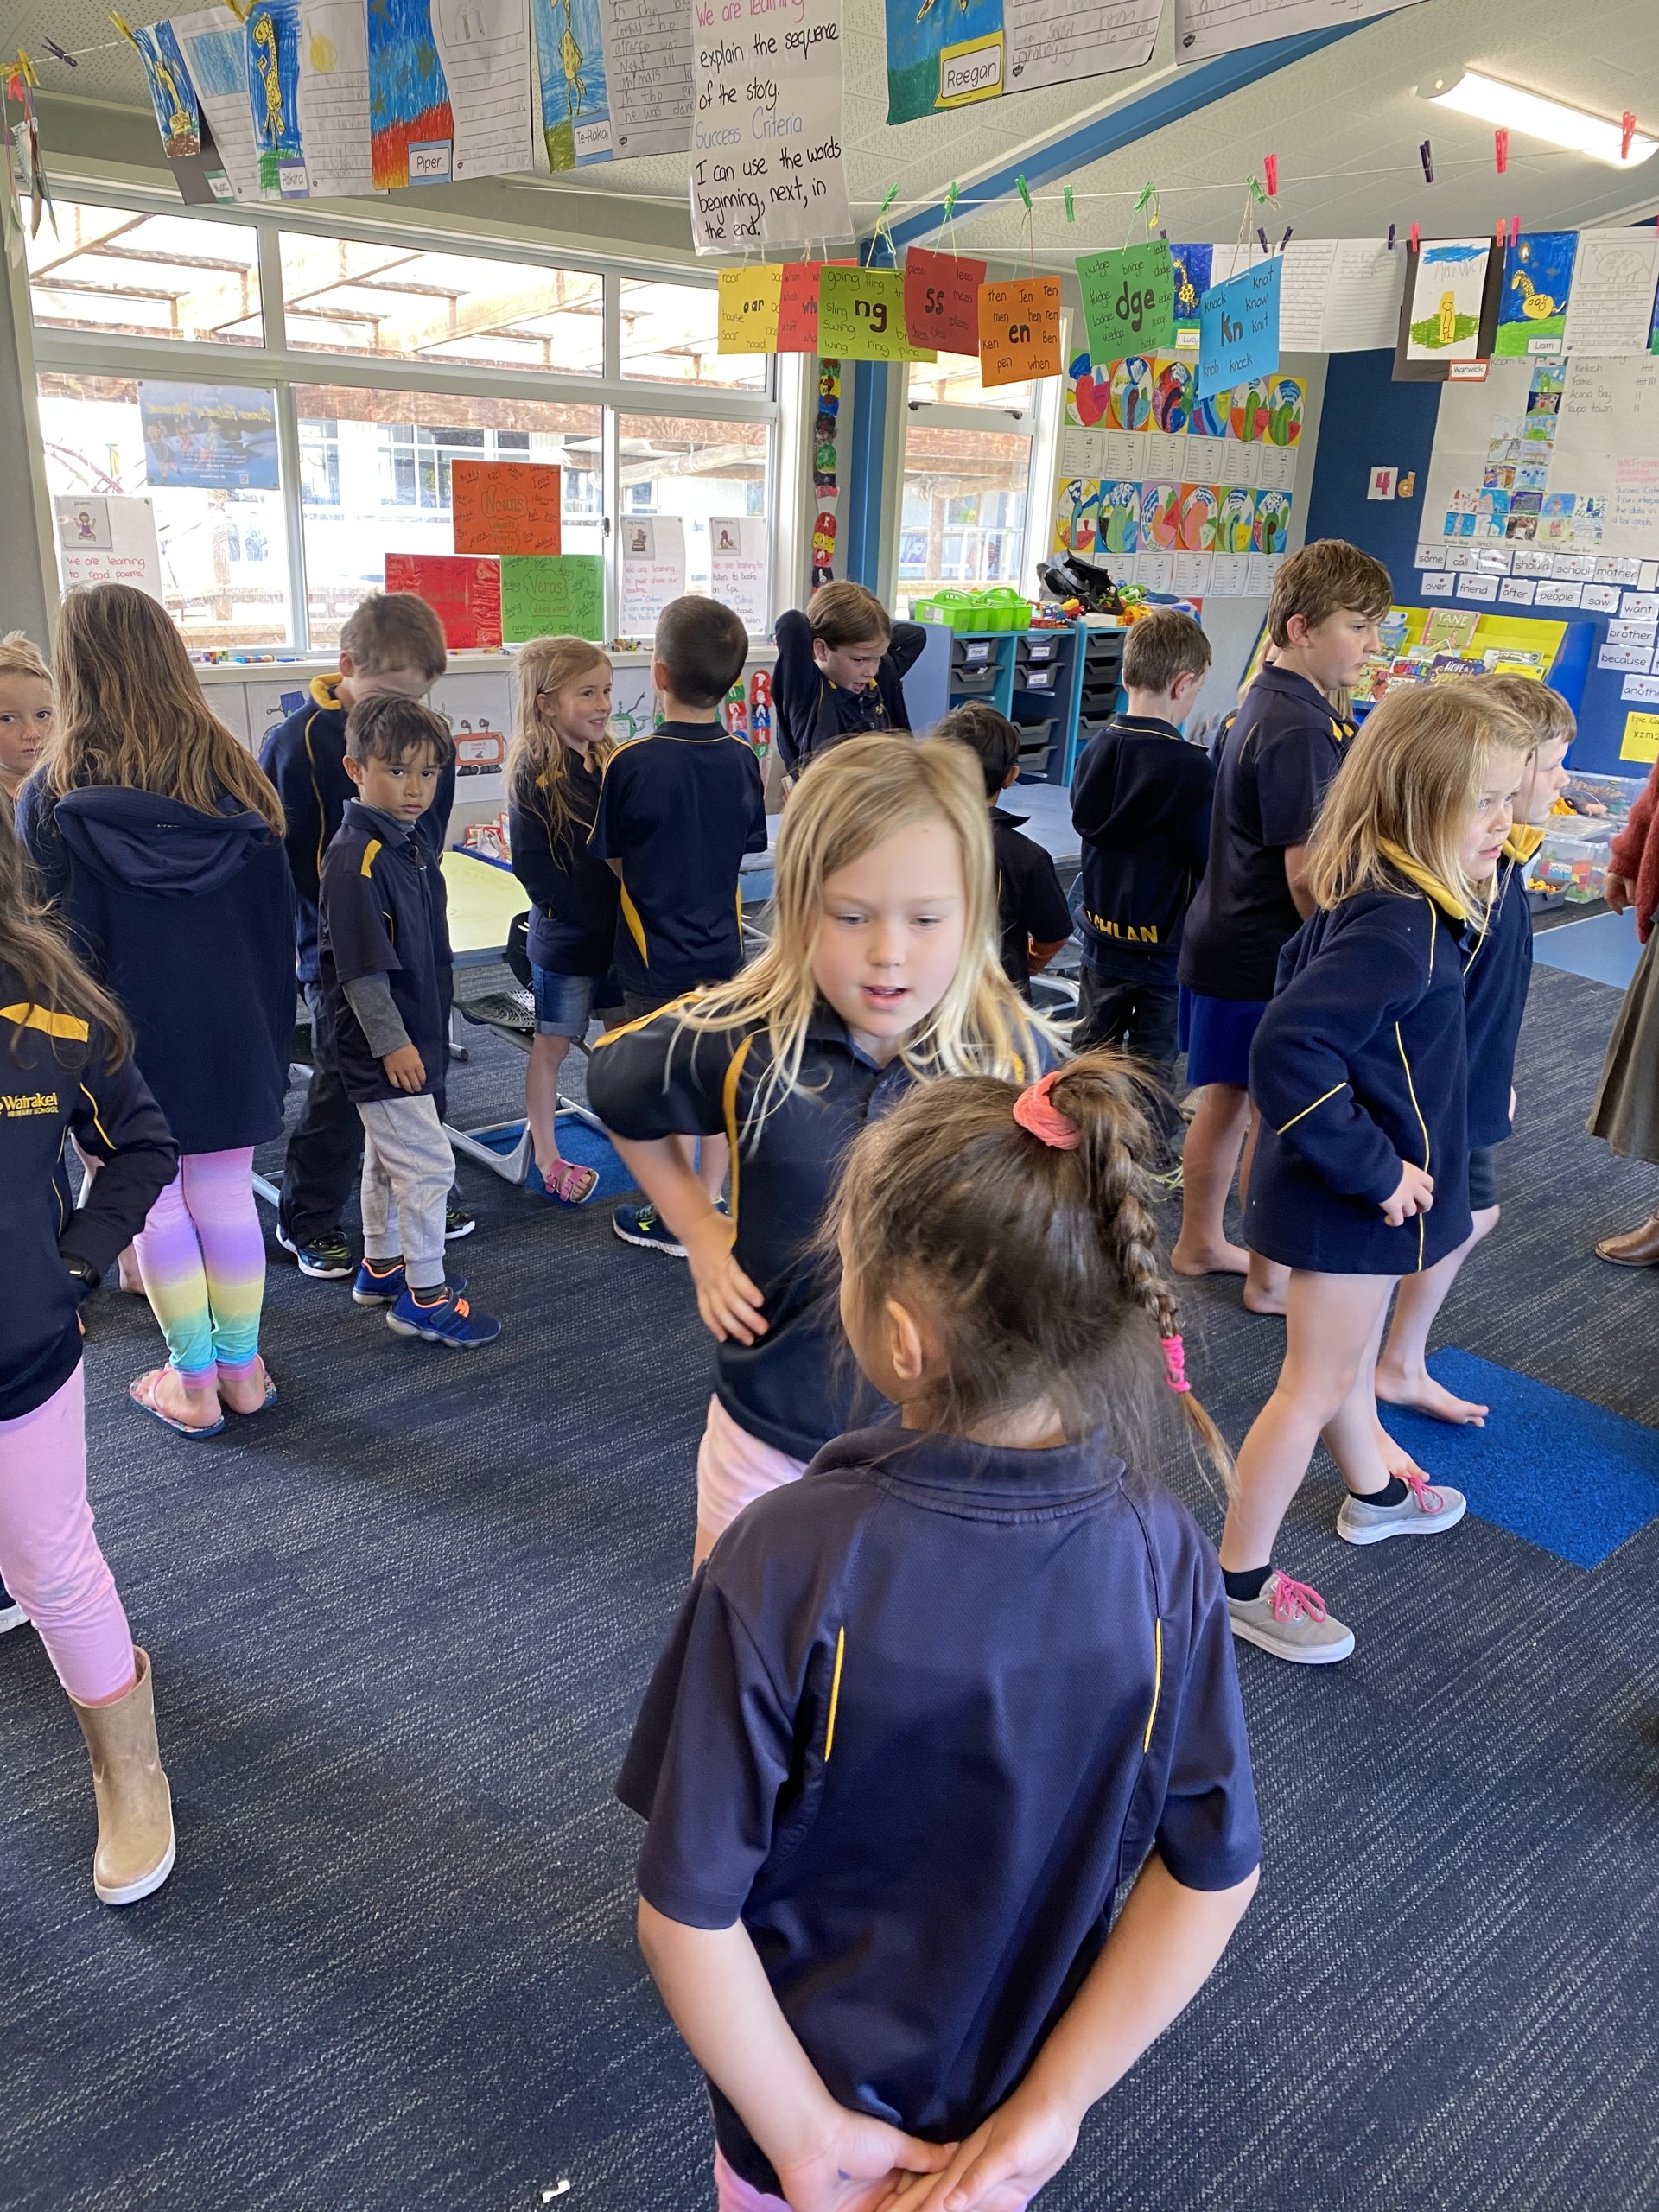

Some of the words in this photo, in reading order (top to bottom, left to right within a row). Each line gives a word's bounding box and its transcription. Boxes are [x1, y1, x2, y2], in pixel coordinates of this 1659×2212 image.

[696, 2, 714, 27] We
[722, 2, 741, 21] are
[700, 40, 744, 74] explain
[753, 33, 778, 55] the
[785, 23, 839, 60] sequence
[947, 61, 997, 88] Reegan
[699, 80, 714, 110] of
[719, 83, 737, 105] the
[747, 77, 780, 111] story.
[625, 109, 636, 124] he
[643, 105, 661, 120] was
[696, 120, 741, 149] Success
[752, 105, 803, 140] Criteria
[416, 156, 442, 174] Piper
[695, 159, 708, 186] I
[713, 165, 734, 182] can
[742, 157, 768, 176] use
[779, 147, 804, 169] the
[807, 135, 842, 163] words
[697, 188, 766, 226] beginning,
[769, 175, 809, 209] next,
[812, 178, 826, 197] in
[705, 221, 727, 239] the
[733, 216, 761, 237] end.
[721, 272, 741, 283] roar
[957, 267, 973, 282] less
[1085, 260, 1110, 278] judge
[1122, 260, 1144, 277] bridge
[827, 271, 861, 291] going
[865, 273, 885, 295] fling
[953, 290, 973, 304] mess
[988, 289, 1007, 302] then
[1018, 289, 1033, 303] Jen
[1044, 282, 1058, 296] ten
[994, 313, 1009, 323] men
[1028, 308, 1042, 323] hen
[1116, 281, 1155, 332] dge
[826, 302, 848, 323] sling
[855, 299, 887, 333] ng
[721, 331, 740, 341] soar
[1008, 324, 1031, 344] en
[825, 340, 848, 355] wing
[867, 340, 889, 357] ring
[899, 347, 920, 360] ping
[1535, 341, 1554, 350] Liam
[997, 357, 1013, 373] pen
[1028, 355, 1050, 371] when
[1453, 365, 1484, 374] Warwick
[1376, 471, 1390, 495] 4
[66, 556, 82, 566] We
[85, 556, 100, 566] are
[107, 555, 145, 570] learning
[625, 563, 634, 573] We
[1516, 561, 1549, 570] should
[1557, 566, 1590, 575] school
[1597, 569, 1637, 578] mother
[68, 569, 79, 579] to
[88, 569, 111, 579] read
[529, 574, 562, 594] Verbs
[1460, 583, 1488, 594] friend
[1503, 588, 1528, 599] after
[1540, 592, 1573, 603] people
[1624, 605, 1653, 614] want
[1439, 613, 1469, 626] TANE
[1609, 629, 1652, 640] brother
[1601, 654, 1646, 666] because
[1631, 715, 1646, 725] Epic
